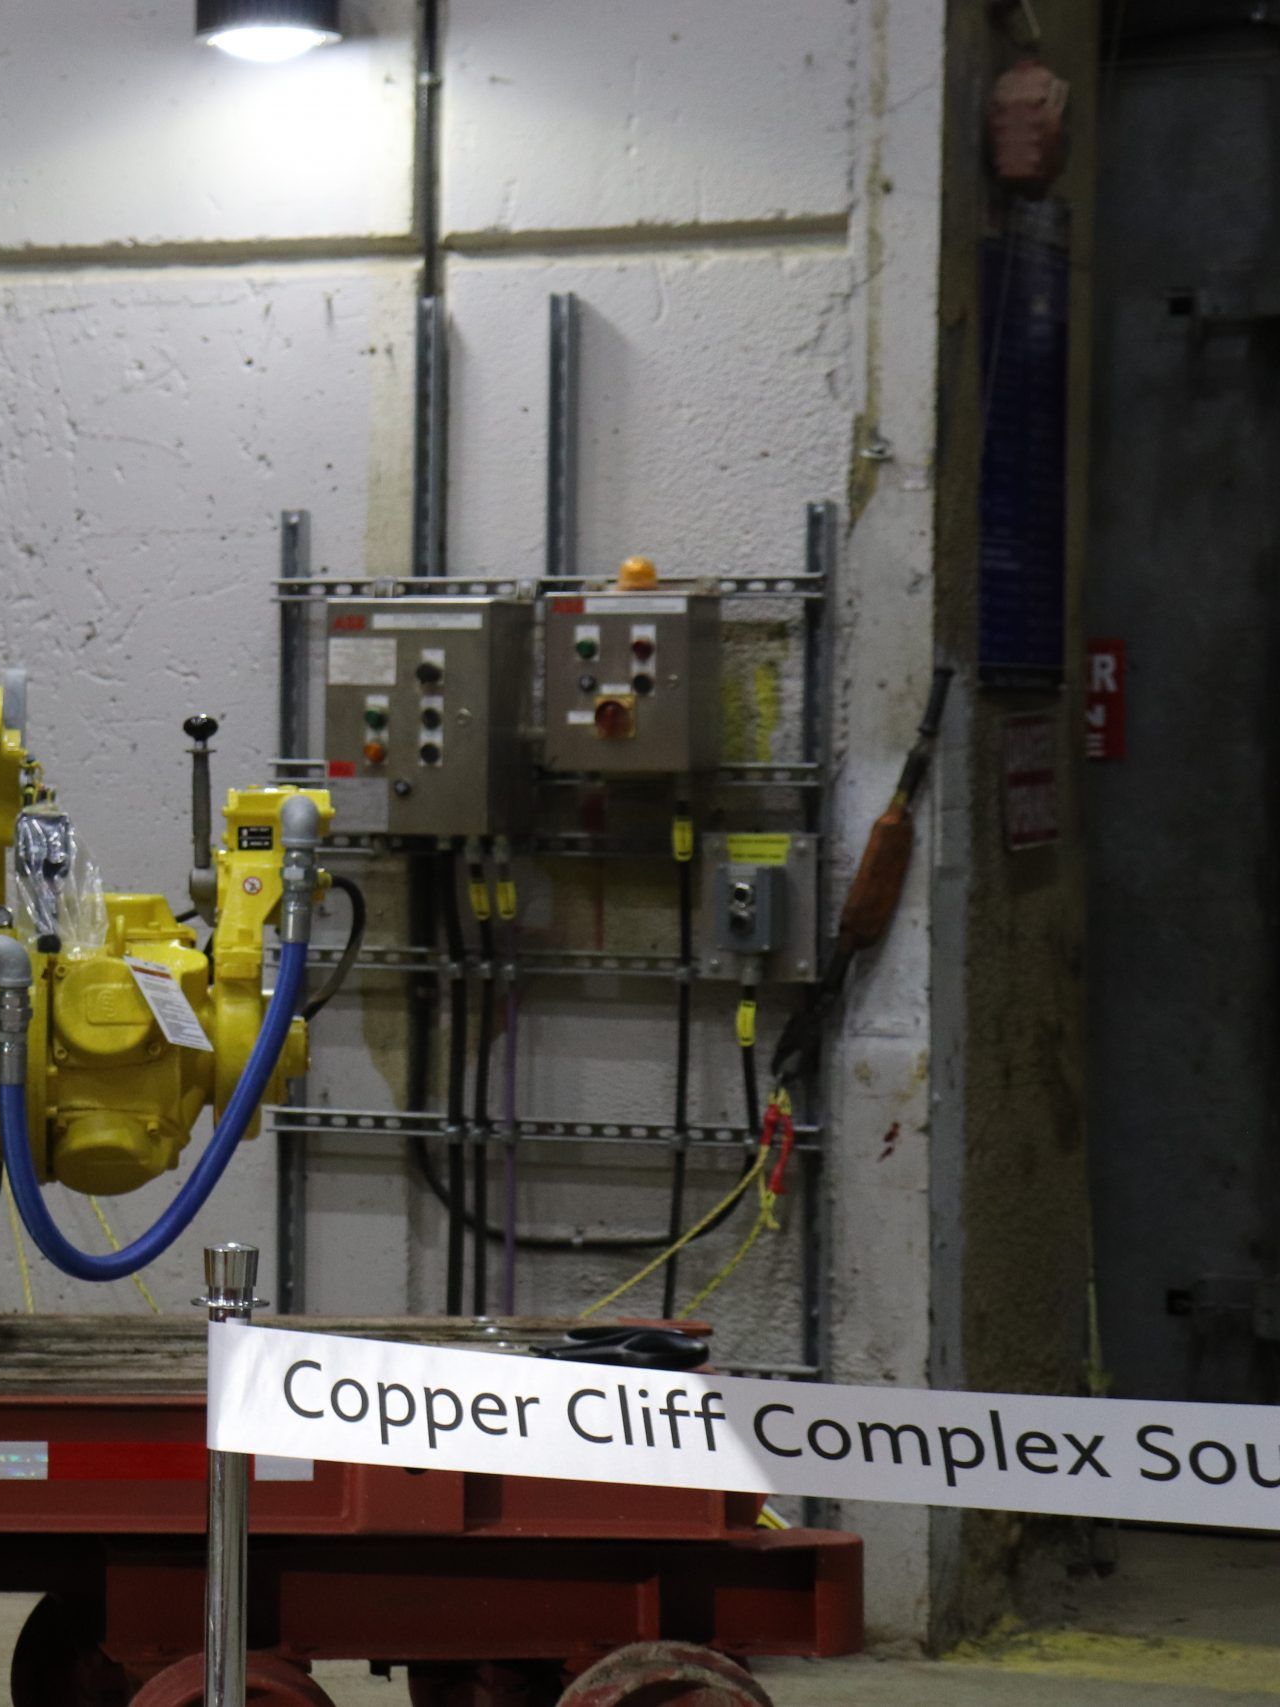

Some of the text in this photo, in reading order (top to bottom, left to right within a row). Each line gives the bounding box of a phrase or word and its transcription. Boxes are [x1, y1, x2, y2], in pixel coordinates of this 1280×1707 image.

[283, 1359, 540, 1449] Copper
[566, 1384, 726, 1451] Cliff
[753, 1403, 1112, 1487] Complex
